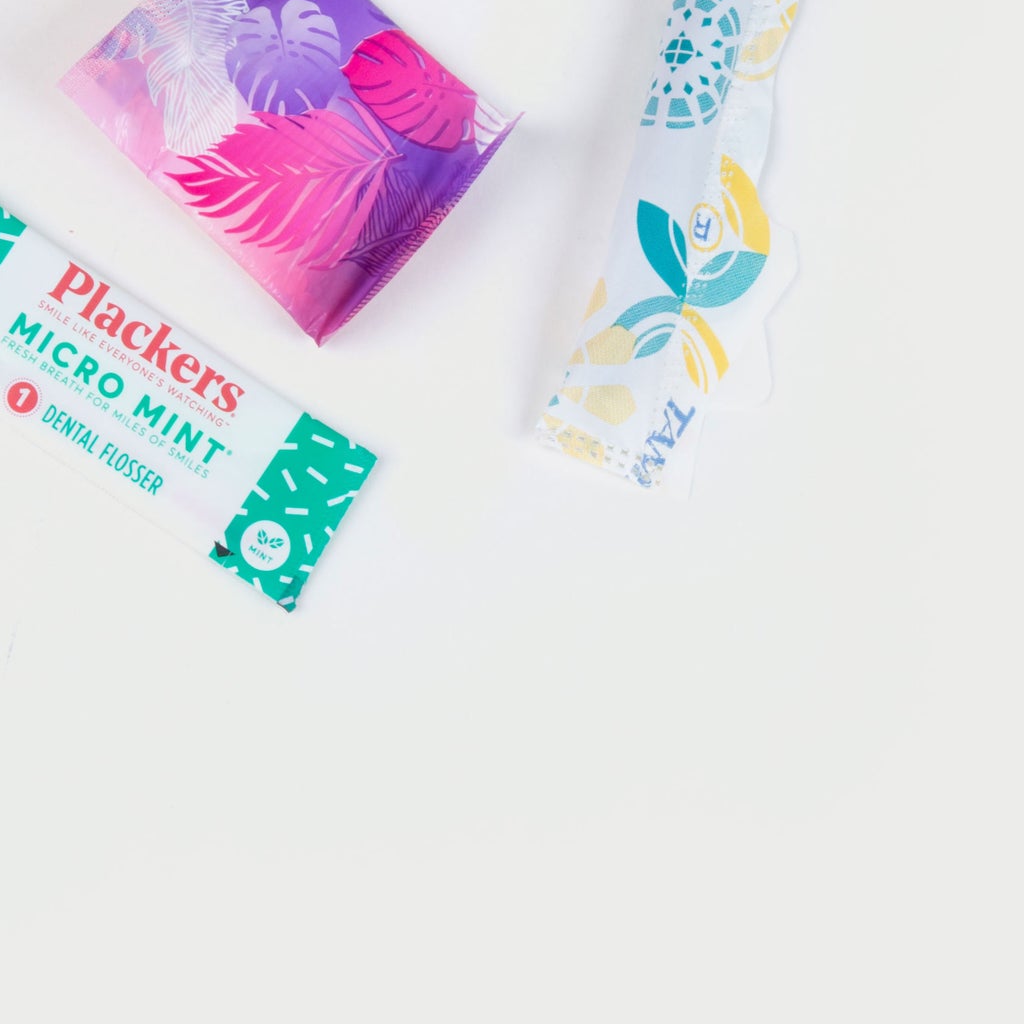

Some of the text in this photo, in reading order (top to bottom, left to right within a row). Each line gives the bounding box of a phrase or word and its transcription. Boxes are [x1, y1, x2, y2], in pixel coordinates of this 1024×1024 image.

[7, 312, 125, 399] MICRO
[37, 298, 71, 326] SMILE
[71, 321, 97, 343] LIKE
[97, 338, 165, 388] EVERYONE'S
[0, 334, 209, 479] FRESH BREATH FOR MILES OF SMILES
[42, 404, 96, 454] DENTAL
[102, 443, 164, 496] FLOSSER
[247, 544, 274, 565] MINT
